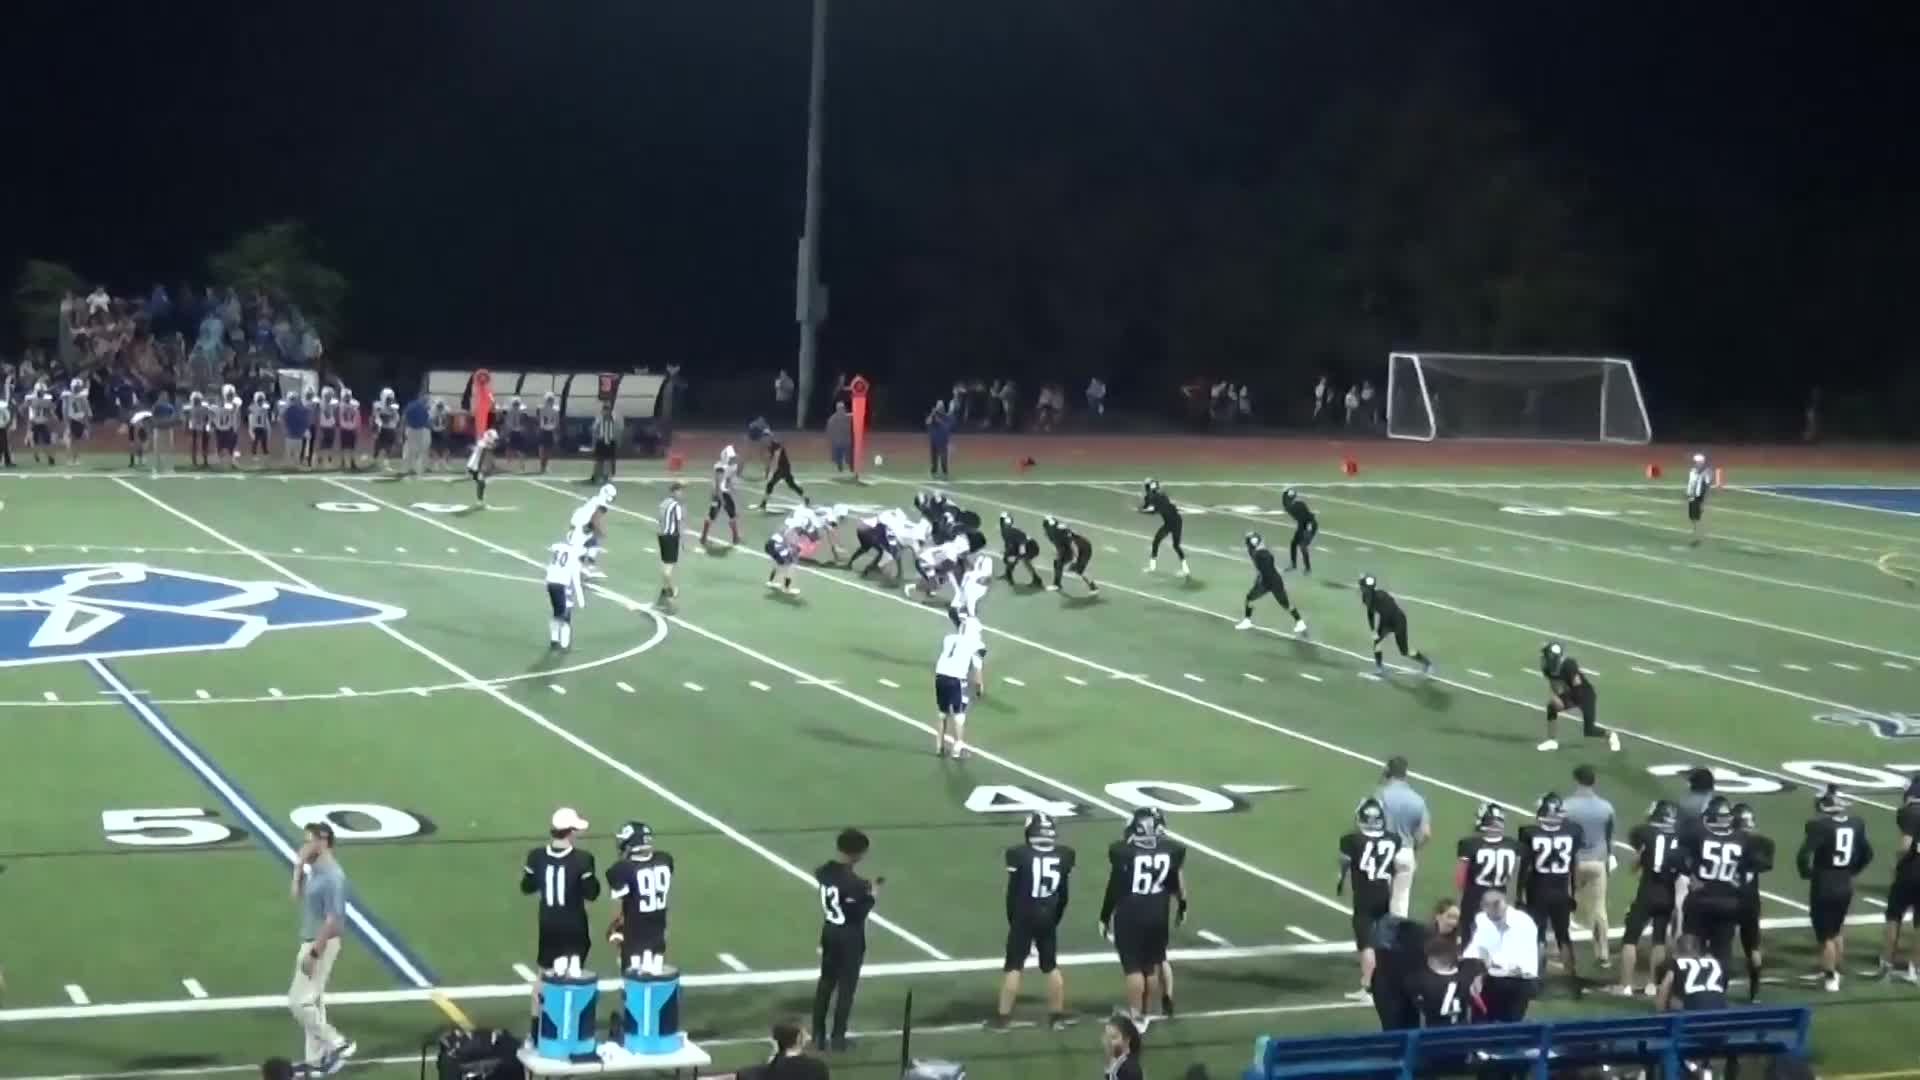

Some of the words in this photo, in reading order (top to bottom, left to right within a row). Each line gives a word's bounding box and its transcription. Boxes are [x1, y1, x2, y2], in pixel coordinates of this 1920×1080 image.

[964, 780, 1235, 817] 40
[102, 803, 421, 845] 50
[1359, 839, 1396, 881] 42
[1475, 847, 1516, 887] 20
[1532, 835, 1573, 874] 23
[1699, 840, 1742, 883] 56
[1832, 827, 1854, 867] 9
[545, 864, 566, 907] 11
[637, 865, 671, 913] 99
[1031, 856, 1061, 898] 15
[1131, 853, 1171, 895] 62
[1676, 956, 1724, 994] 22
